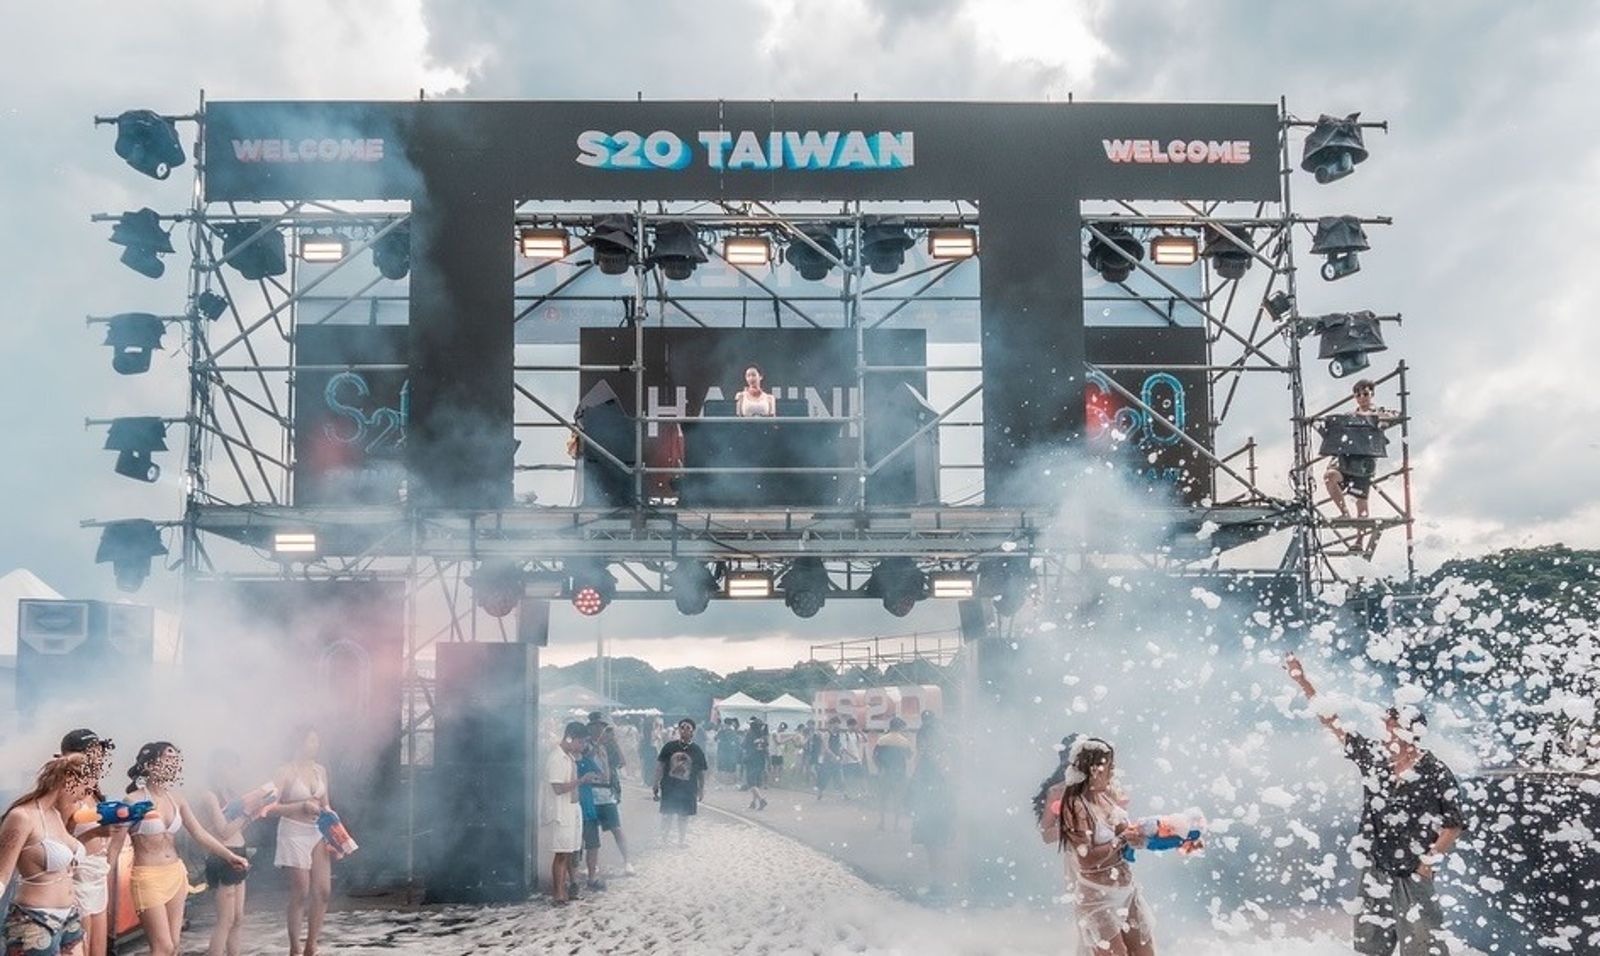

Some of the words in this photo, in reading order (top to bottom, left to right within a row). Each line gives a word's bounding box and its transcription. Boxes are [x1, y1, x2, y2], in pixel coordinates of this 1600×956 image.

[231, 138, 385, 162] WELCOME
[698, 131, 915, 170] TAIWAN
[1102, 139, 1251, 163] WELCOME
[319, 371, 410, 455] S2
